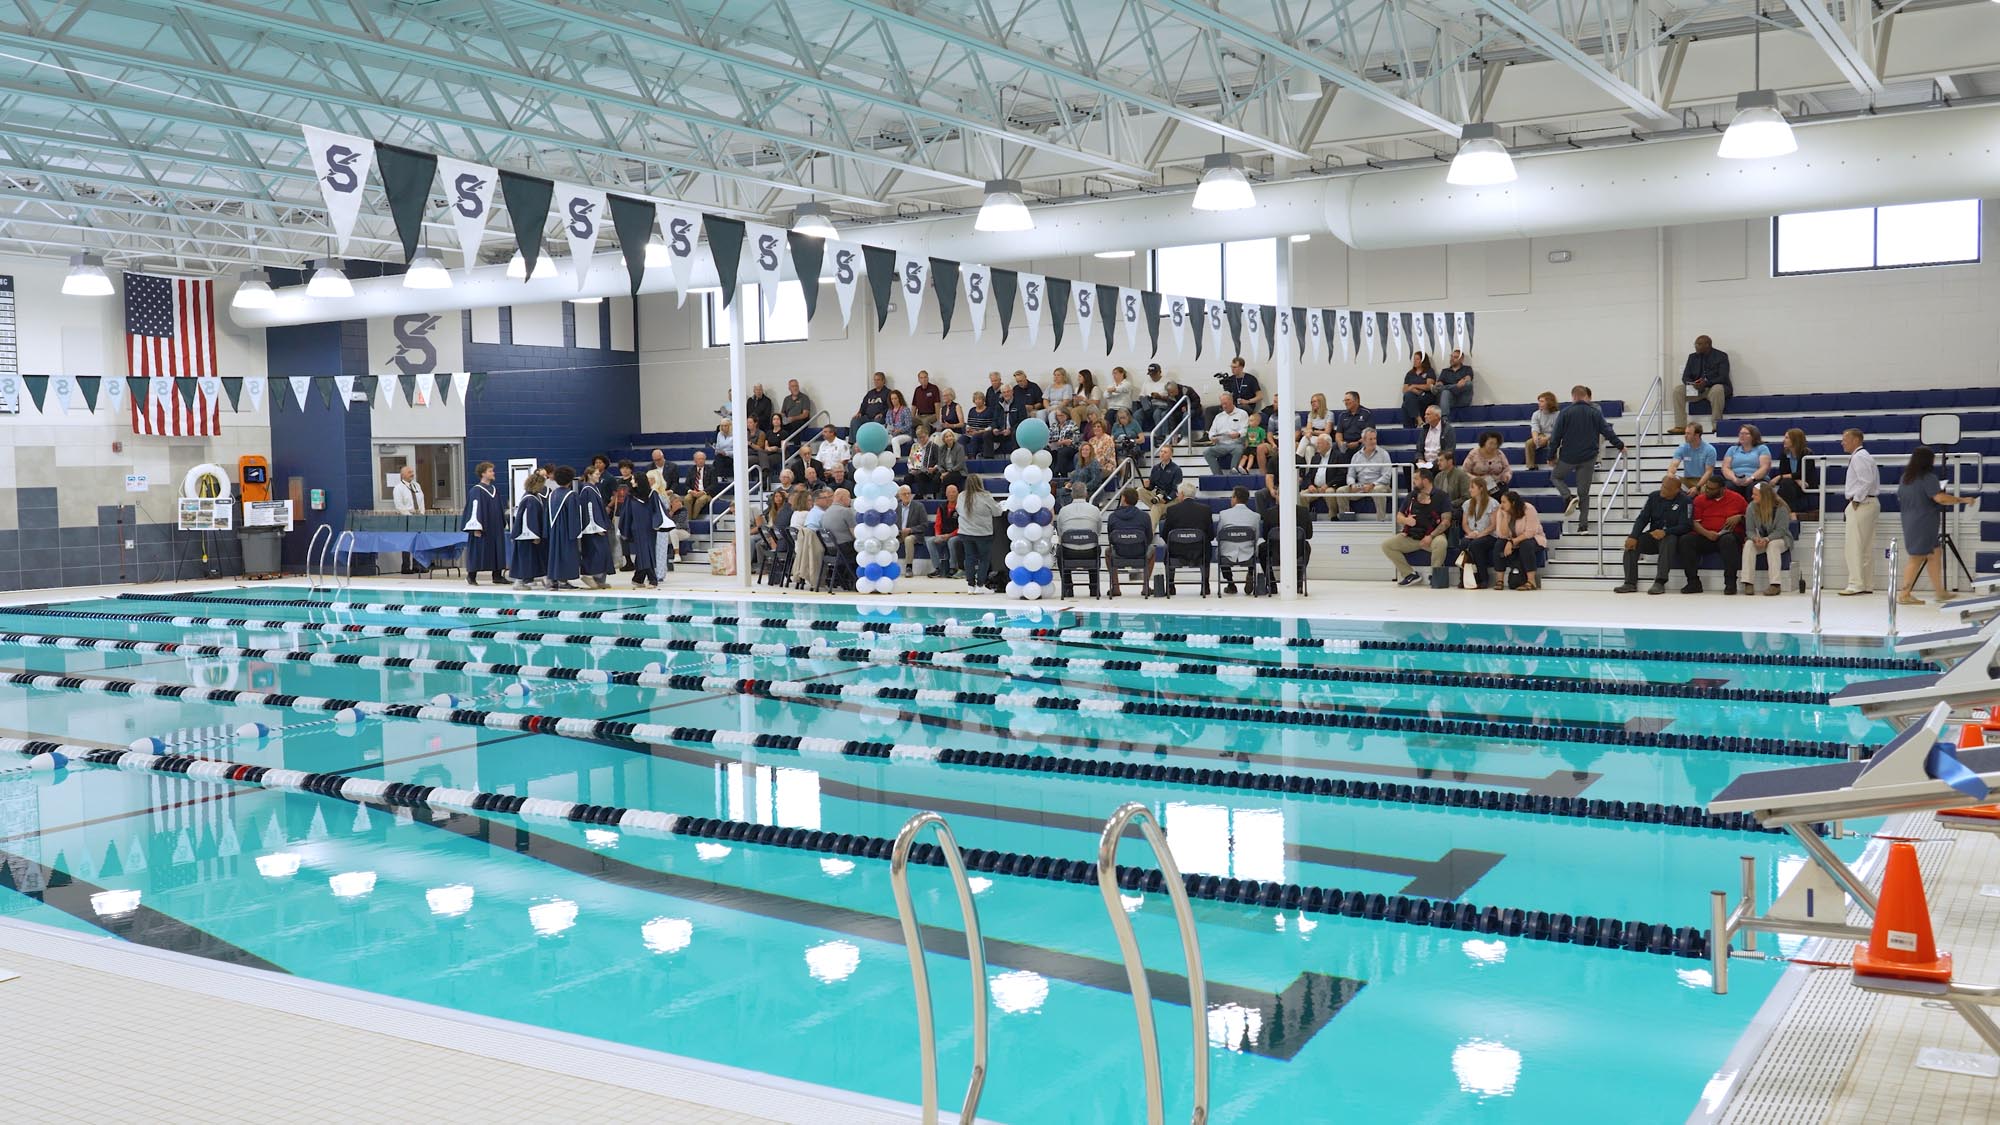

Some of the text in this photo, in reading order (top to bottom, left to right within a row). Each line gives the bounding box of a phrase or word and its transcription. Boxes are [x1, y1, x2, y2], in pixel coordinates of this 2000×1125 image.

[321, 144, 362, 193] S
[452, 173, 487, 219] S
[567, 197, 596, 239] S
[668, 218, 693, 258] S
[756, 234, 779, 271] S
[835, 249, 855, 285] S
[904, 261, 923, 294] S
[385, 313, 442, 374] S
